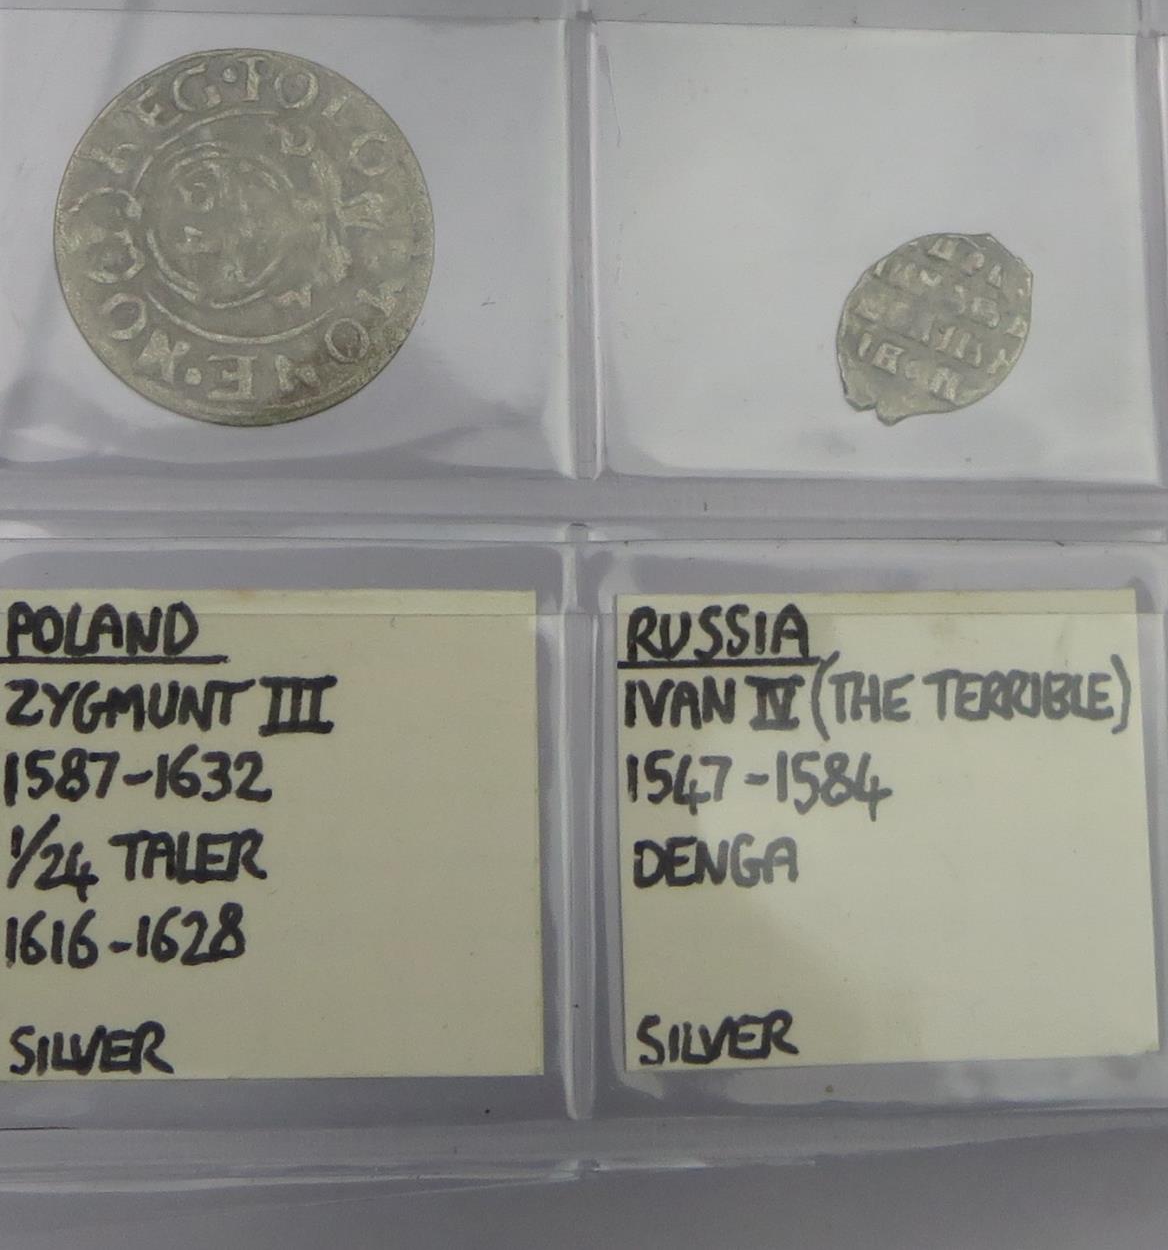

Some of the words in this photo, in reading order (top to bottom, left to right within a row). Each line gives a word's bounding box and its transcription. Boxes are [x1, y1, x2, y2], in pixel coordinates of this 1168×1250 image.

[6, 601, 199, 657] POLAND
[626, 604, 809, 662] RUSSIA
[5, 678, 255, 734] ZYGMUNT
[258, 675, 338, 736] III
[624, 675, 736, 729] IVAN
[744, 674, 805, 731] IV
[811, 651, 914, 741] (THE
[922, 653, 1131, 735] TERRIBLE)
[6, 813, 99, 902] 1/24
[108, 829, 267, 884] TALER
[634, 834, 799, 888] DENGA
[9, 1021, 173, 1074] SILVER
[636, 1010, 799, 1066] SILVER
